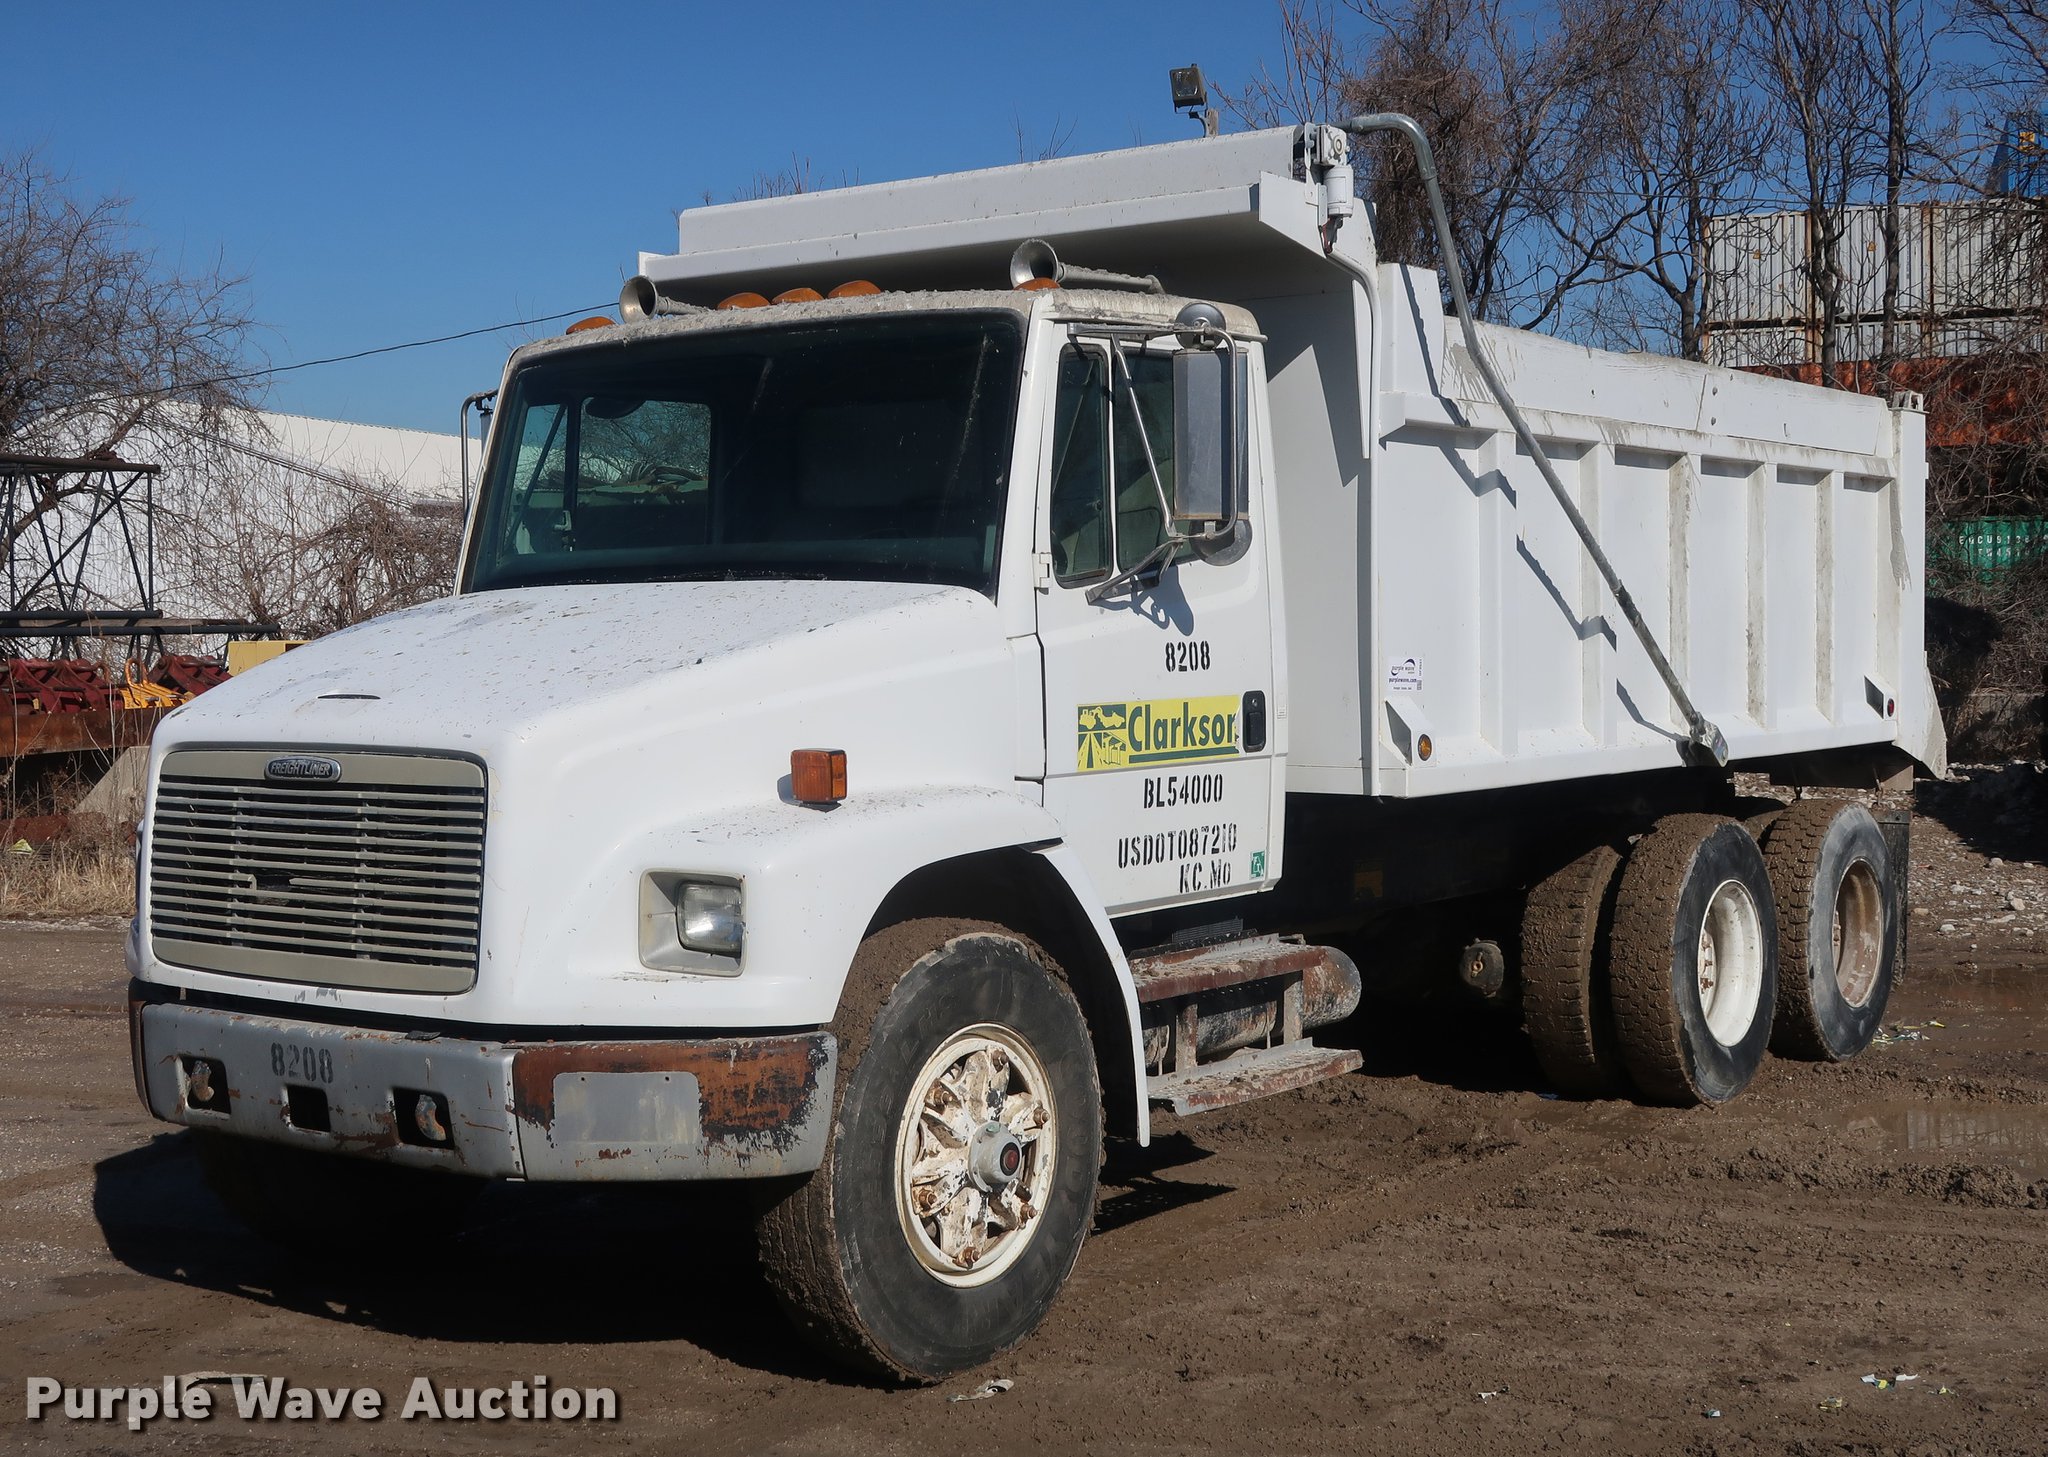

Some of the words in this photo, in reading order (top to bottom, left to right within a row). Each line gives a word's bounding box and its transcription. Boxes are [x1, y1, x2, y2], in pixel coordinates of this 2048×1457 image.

[1165, 641, 1211, 672] 8208
[271, 760, 330, 775] FREIGHTLINER
[1144, 774, 1224, 809] BL54000
[271, 1042, 334, 1084] 8208
